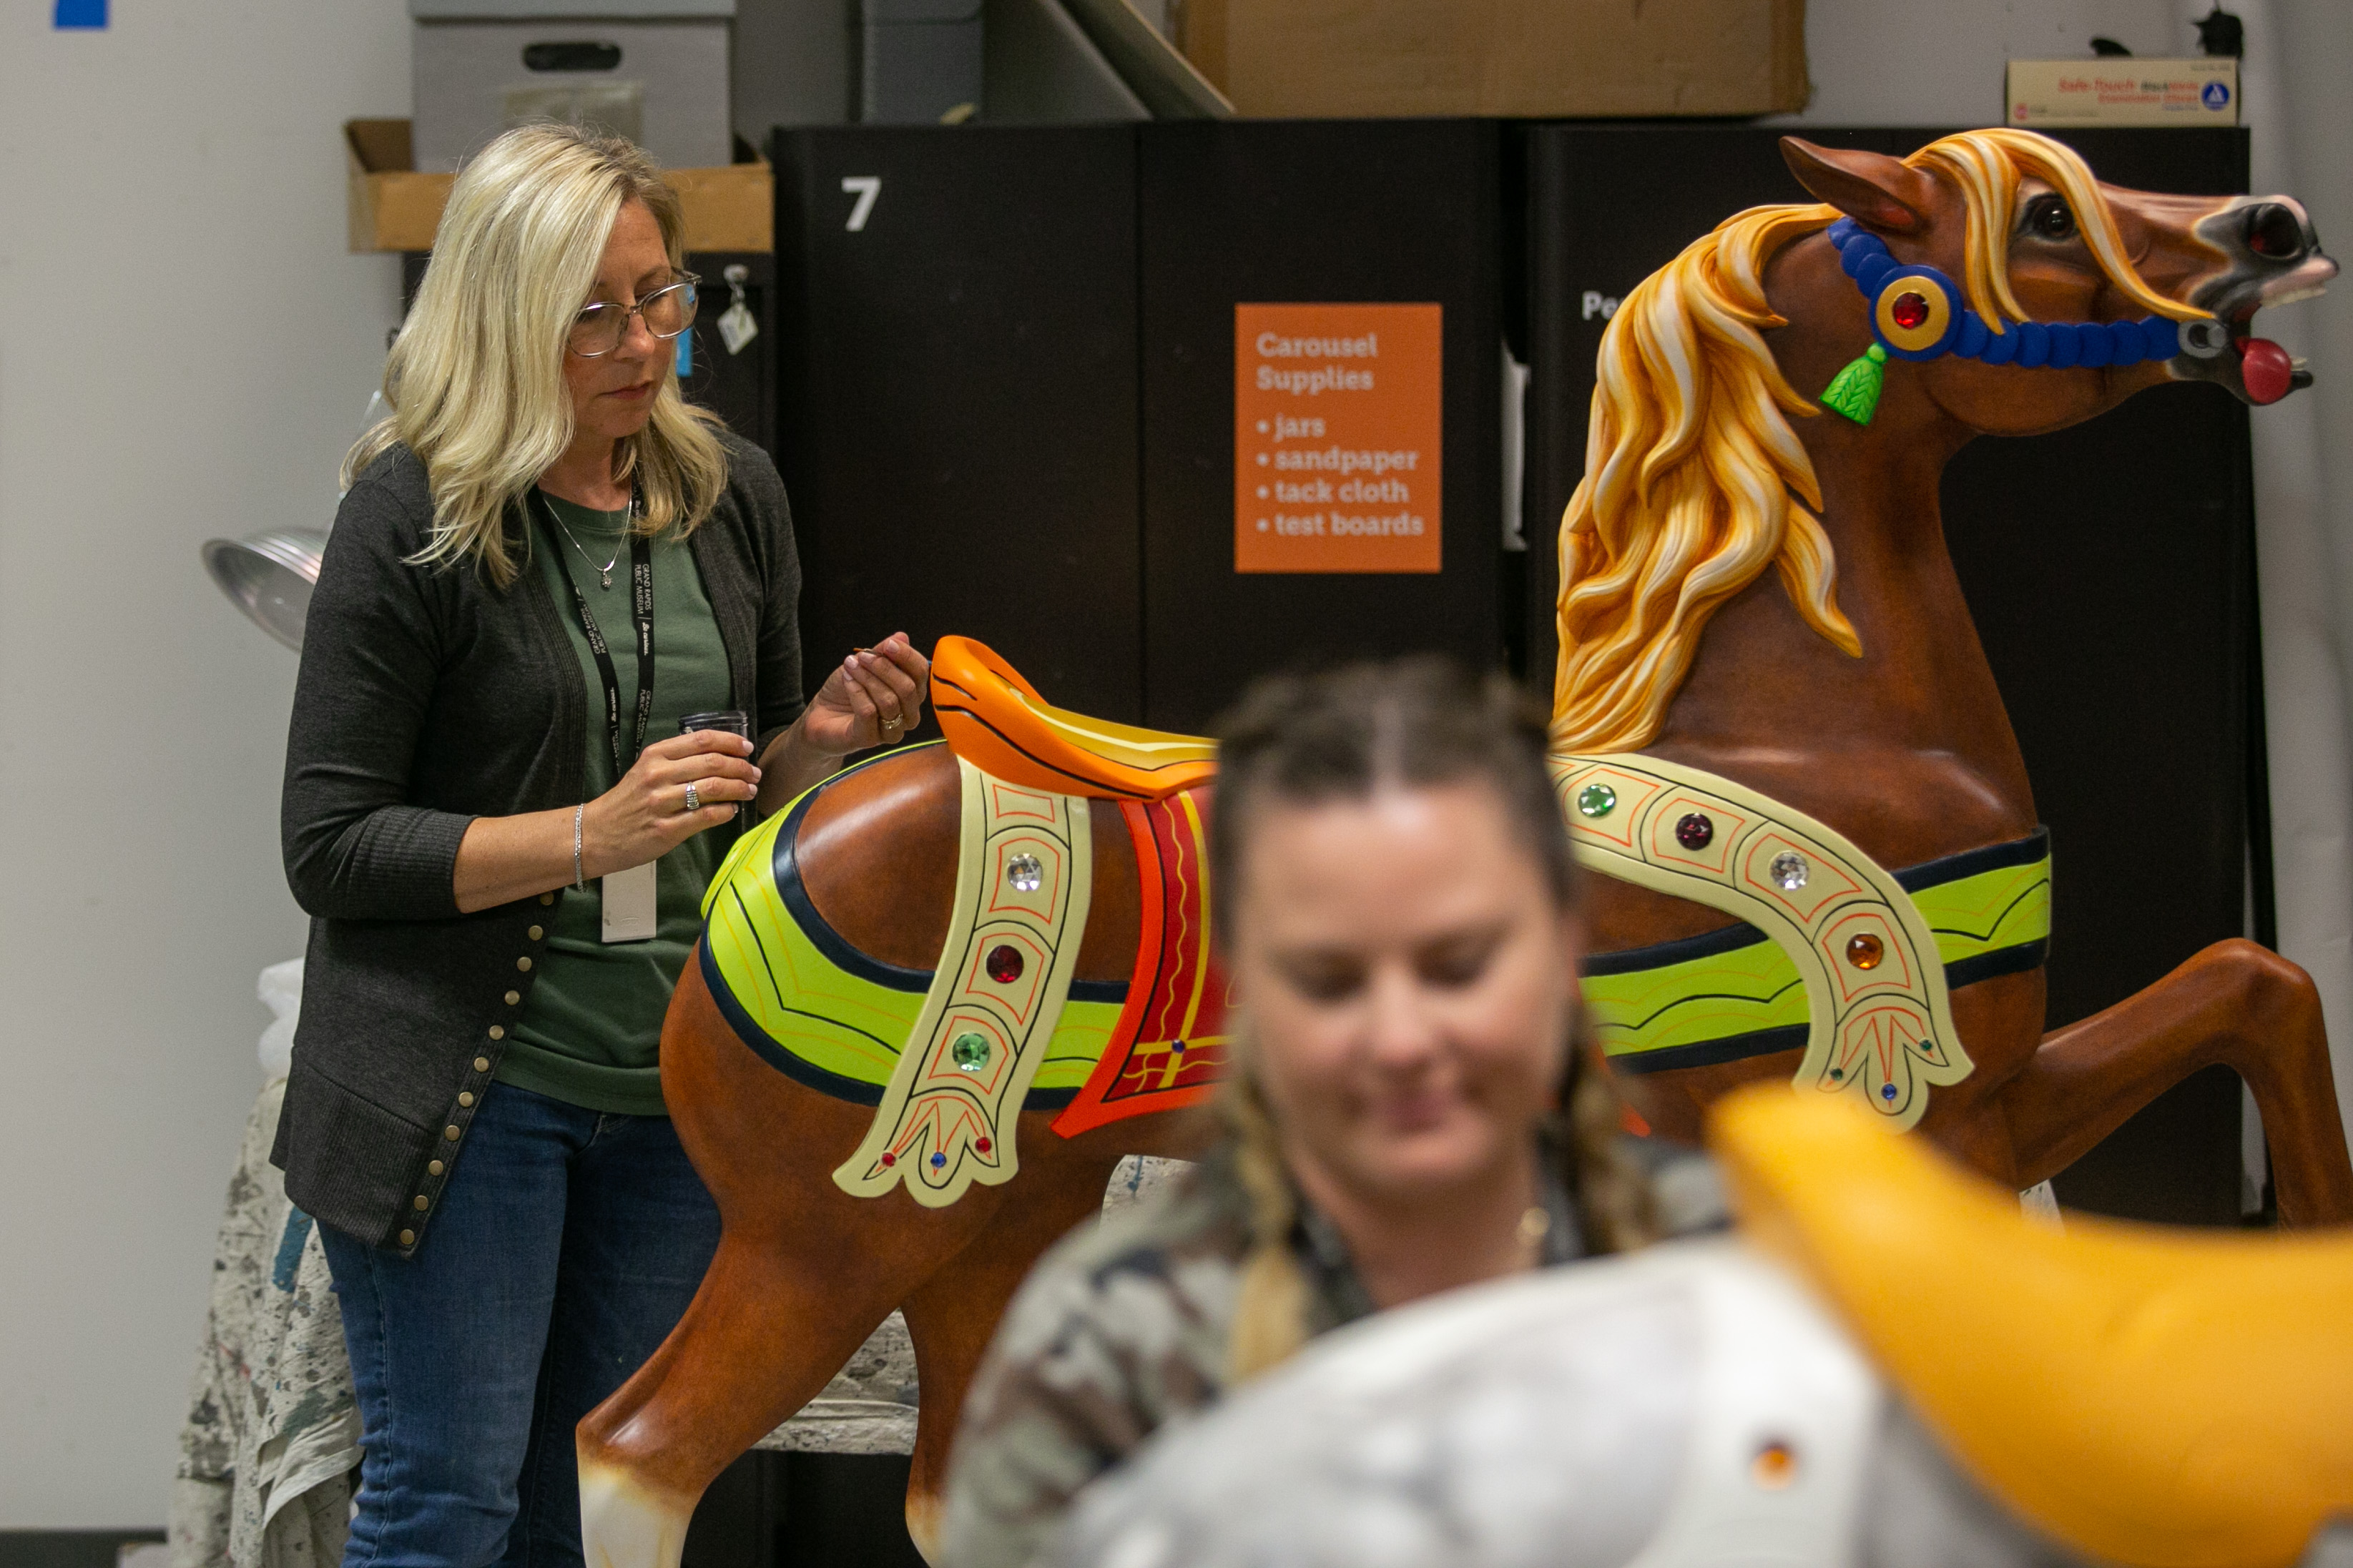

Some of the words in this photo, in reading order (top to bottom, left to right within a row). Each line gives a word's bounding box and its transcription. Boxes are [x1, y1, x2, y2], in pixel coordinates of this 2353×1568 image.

[841, 176, 882, 232] 7
[1582, 290, 1623, 320] Pe
[1256, 332, 1378, 358] Carousel
[1256, 365, 1375, 395] Supplies
[1273, 412, 1326, 442] jars
[1274, 445, 1420, 475] sandpaper
[1274, 478, 1333, 503] tack
[1338, 478, 1410, 503] cloth
[1274, 512, 1325, 536] test
[1330, 511, 1425, 536] boards
[642, 563, 651, 587] GRAND
[588, 630, 601, 654] GRAND
[594, 633, 607, 654] PUBLIC
